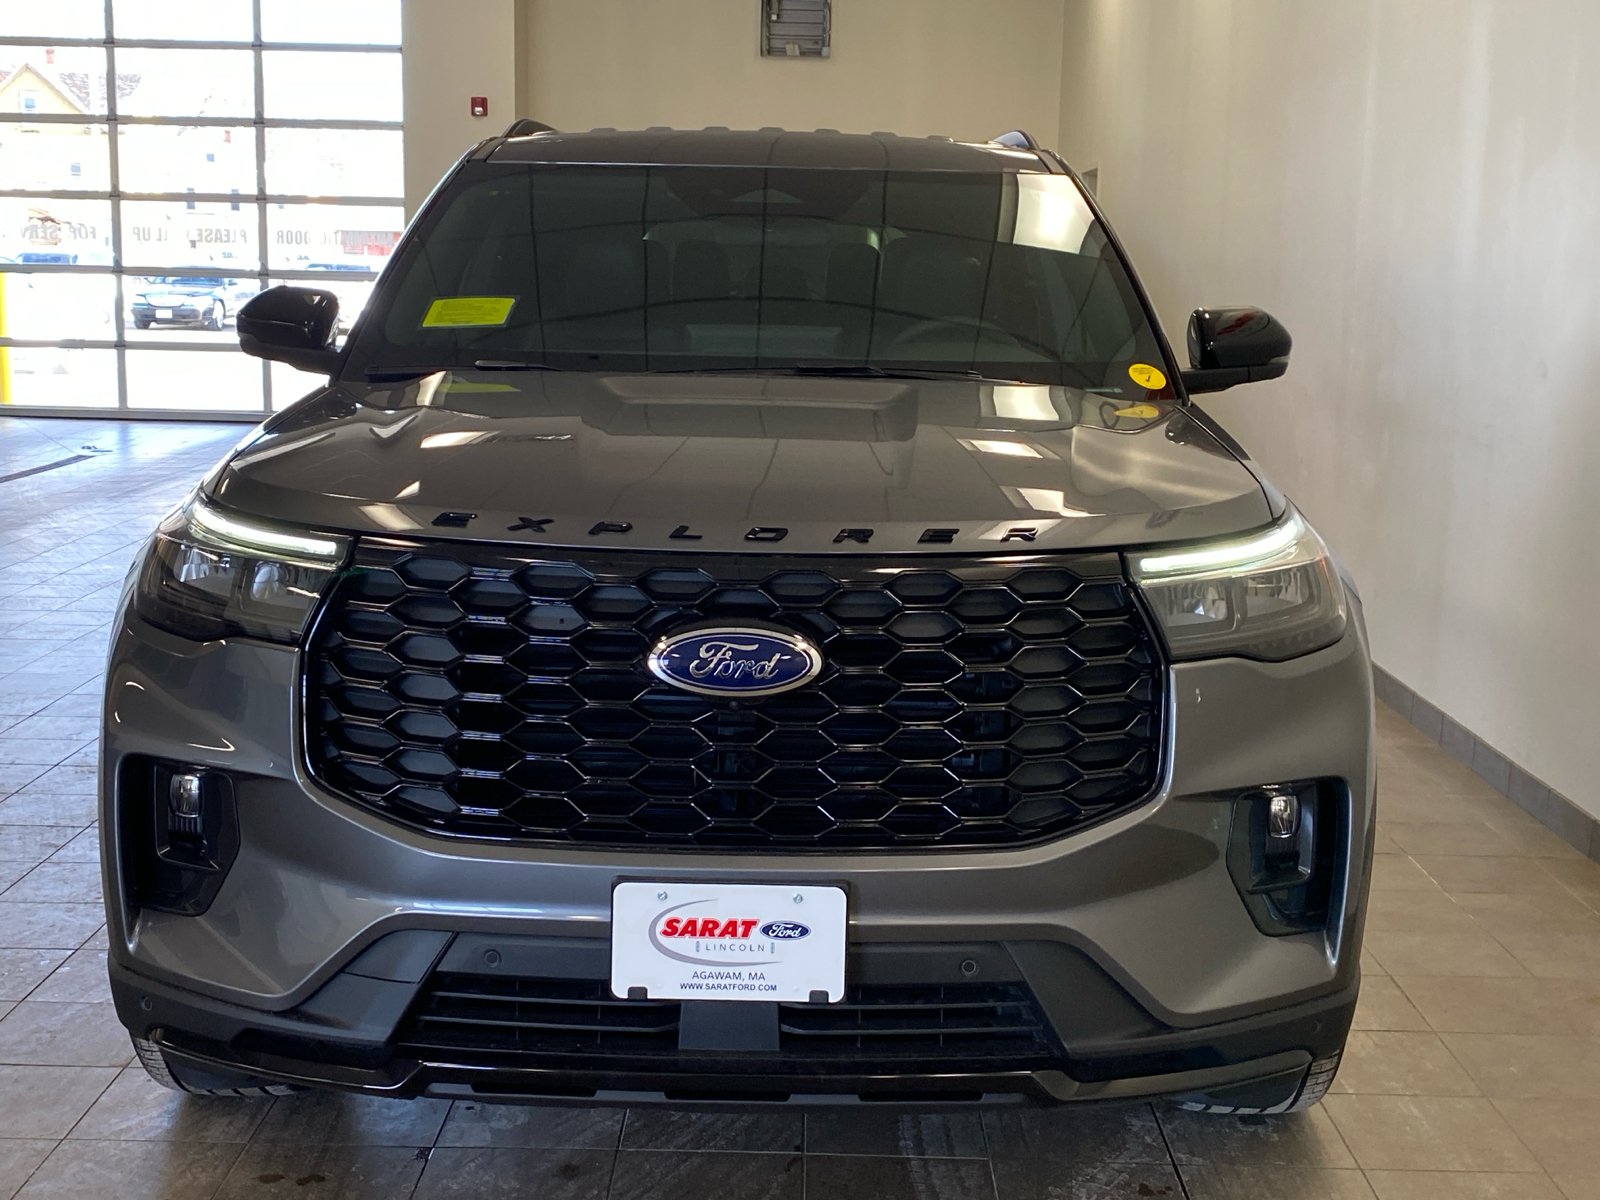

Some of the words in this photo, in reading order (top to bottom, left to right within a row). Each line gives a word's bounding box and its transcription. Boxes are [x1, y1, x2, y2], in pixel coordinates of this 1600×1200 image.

[431, 511, 1038, 543] EXPLORER
[689, 641, 780, 679] Ford
[660, 917, 760, 939] SARAT
[768, 923, 802, 938] Ford
[705, 943, 765, 952] LINCOLN
[692, 971, 745, 982] AGAWAM,
[748, 972, 766, 981] MA
[680, 982, 777, 992] WWW.SARATFORD.COM
